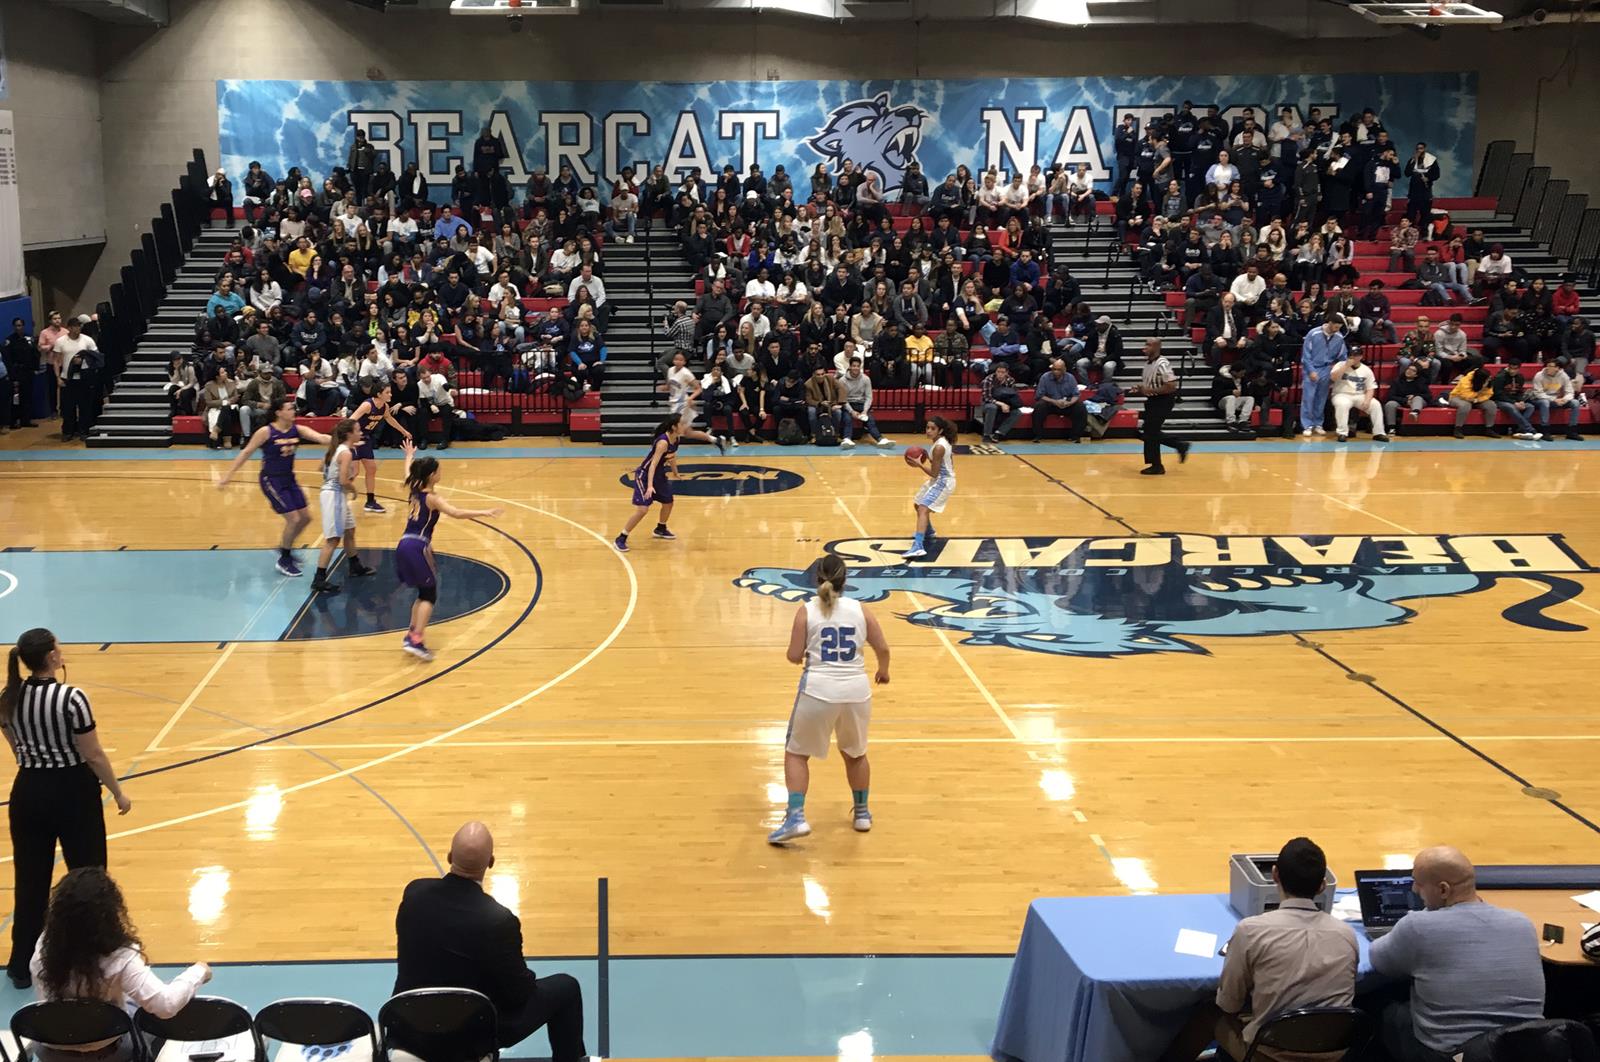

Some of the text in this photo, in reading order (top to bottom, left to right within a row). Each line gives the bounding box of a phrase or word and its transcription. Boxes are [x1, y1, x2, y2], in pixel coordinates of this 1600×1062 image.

[349, 110, 780, 186] BEARCAT
[828, 533, 1592, 574] BEARCATS
[1184, 566, 1448, 576] BARUCH
[820, 626, 857, 662] 25
